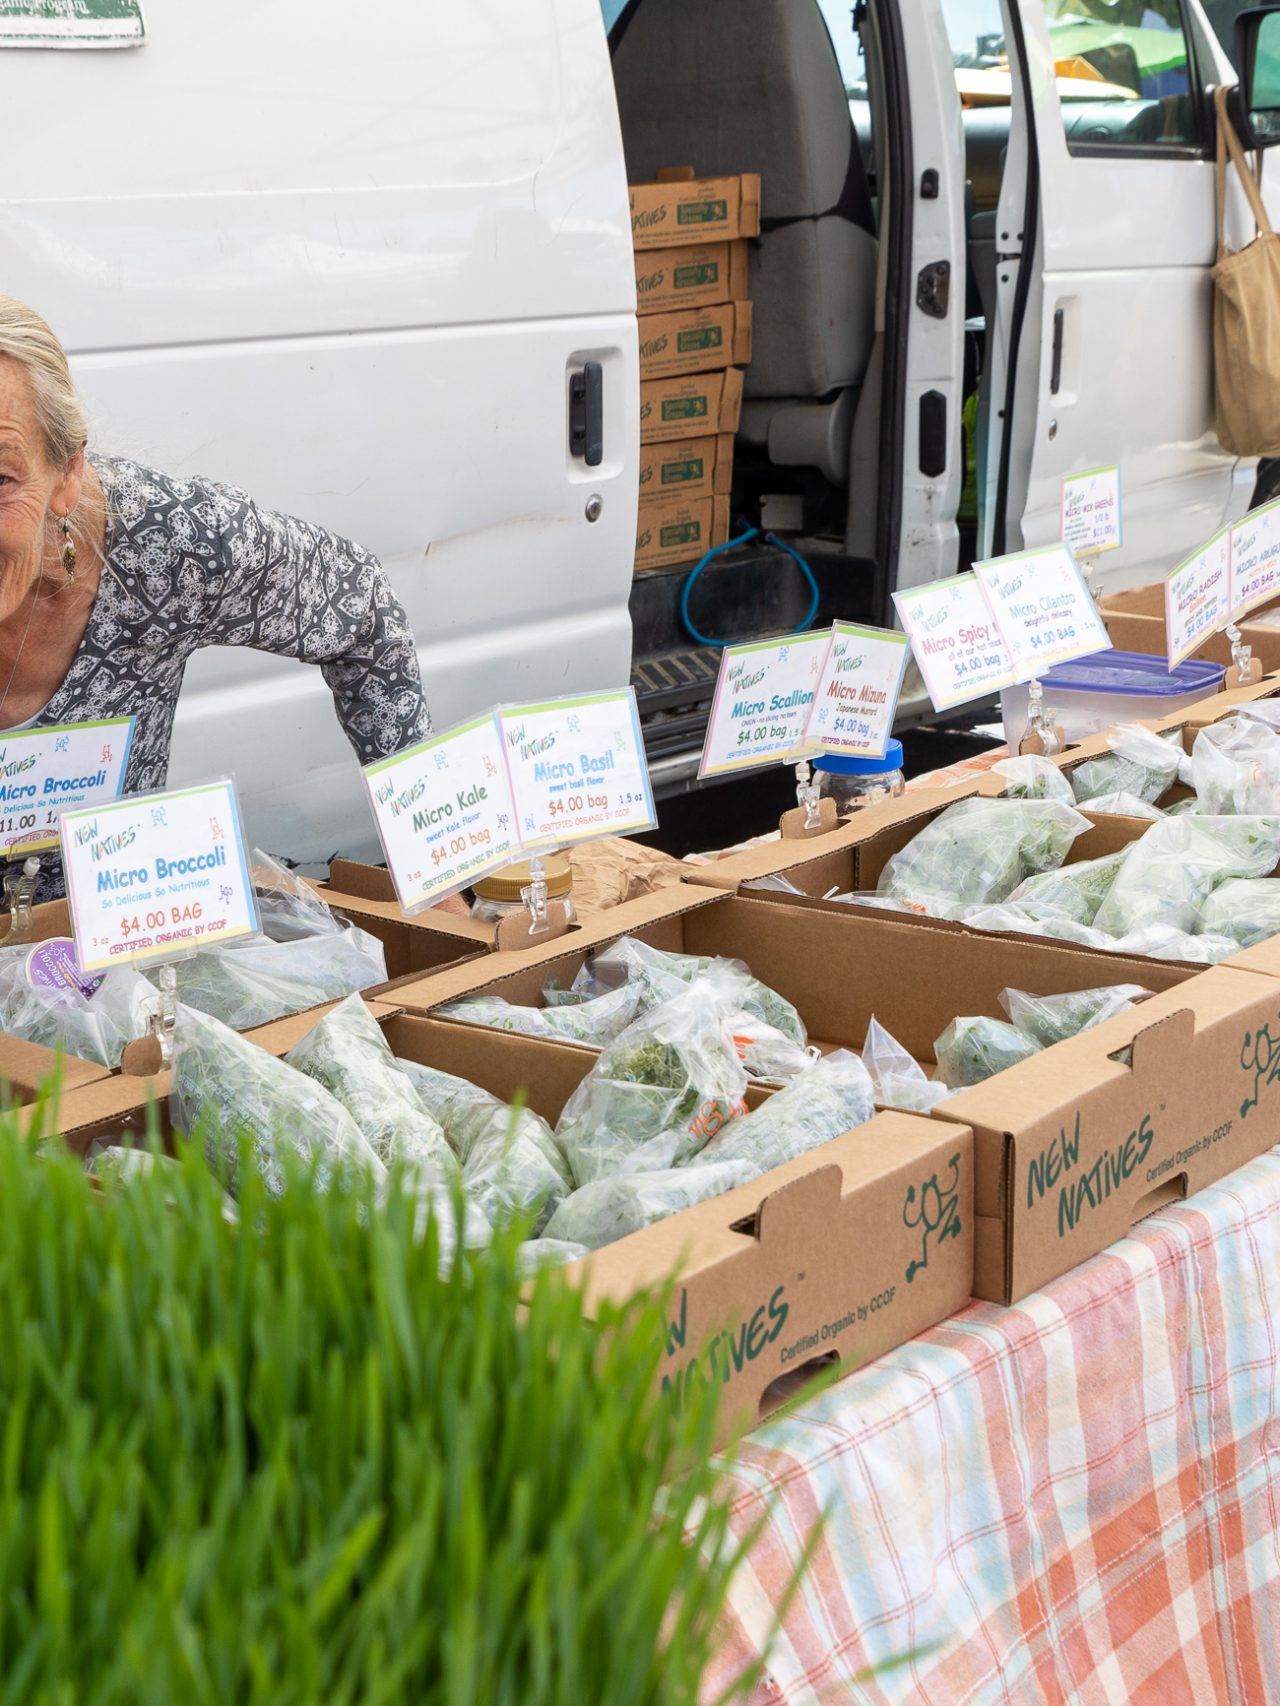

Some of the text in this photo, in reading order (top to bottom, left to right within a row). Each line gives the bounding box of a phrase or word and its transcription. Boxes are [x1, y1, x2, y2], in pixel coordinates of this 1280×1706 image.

[1008, 593, 1077, 619] Micro Cilantro
[921, 625, 990, 656] Micro Spicy
[1030, 631, 1055, 649] $4.00
[1056, 625, 1075, 641] BAG
[954, 654, 1001, 677] $4.00 bag
[731, 690, 814, 719] Micro Scallion
[827, 680, 887, 704] Micro Mizuna
[506, 723, 526, 748] NEW
[737, 726, 766, 746] $4.00
[770, 725, 788, 739] bag
[833, 717, 858, 732] $4.00
[858, 722, 870, 737] bag
[520, 732, 555, 761] NATIVES
[534, 749, 615, 783] Micro Basil
[43, 770, 107, 794] Broccoli
[374, 778, 395, 808] NEW
[548, 776, 605, 793] sweet basil flavor
[4, 803, 34, 814] Delicious
[37, 800, 46, 808] So
[49, 794, 85, 805] Nutritious
[390, 778, 426, 818] NATIVES
[412, 784, 489, 833] Micro Kale
[548, 795, 583, 817] $4.00
[587, 794, 608, 810] bag
[634, 793, 643, 802] oz
[74, 819, 98, 848] NEW
[426, 812, 481, 844] sweet Kale flavor
[539, 818, 574, 833] CERTIFIED
[575, 813, 604, 826] ORGANIC
[606, 811, 614, 819] BY
[90, 825, 136, 863] NATIVES
[431, 828, 491, 867] $4.00 bag
[97, 845, 226, 893] Micro Broccoli
[413, 871, 422, 879] oz
[422, 870, 456, 891] CERTIFIED
[457, 856, 485, 874] ORGANIC
[486, 850, 494, 861] BY
[102, 878, 210, 909] So Delicious So Nutritious
[120, 902, 202, 938] $4.00 BAG
[92, 936, 109, 947] 3 oz
[109, 919, 227, 955] CERTIFIED ORGANIC BY CCOF
[38, 949, 67, 986] BROCCOLI
[1027, 1111, 1081, 1209] NEW
[1146, 1120, 1233, 1183] Certified Organic by CCOF
[1058, 1114, 1154, 1238] NATIVES
[780, 1286, 897, 1364] Certified Organic by CCOF
